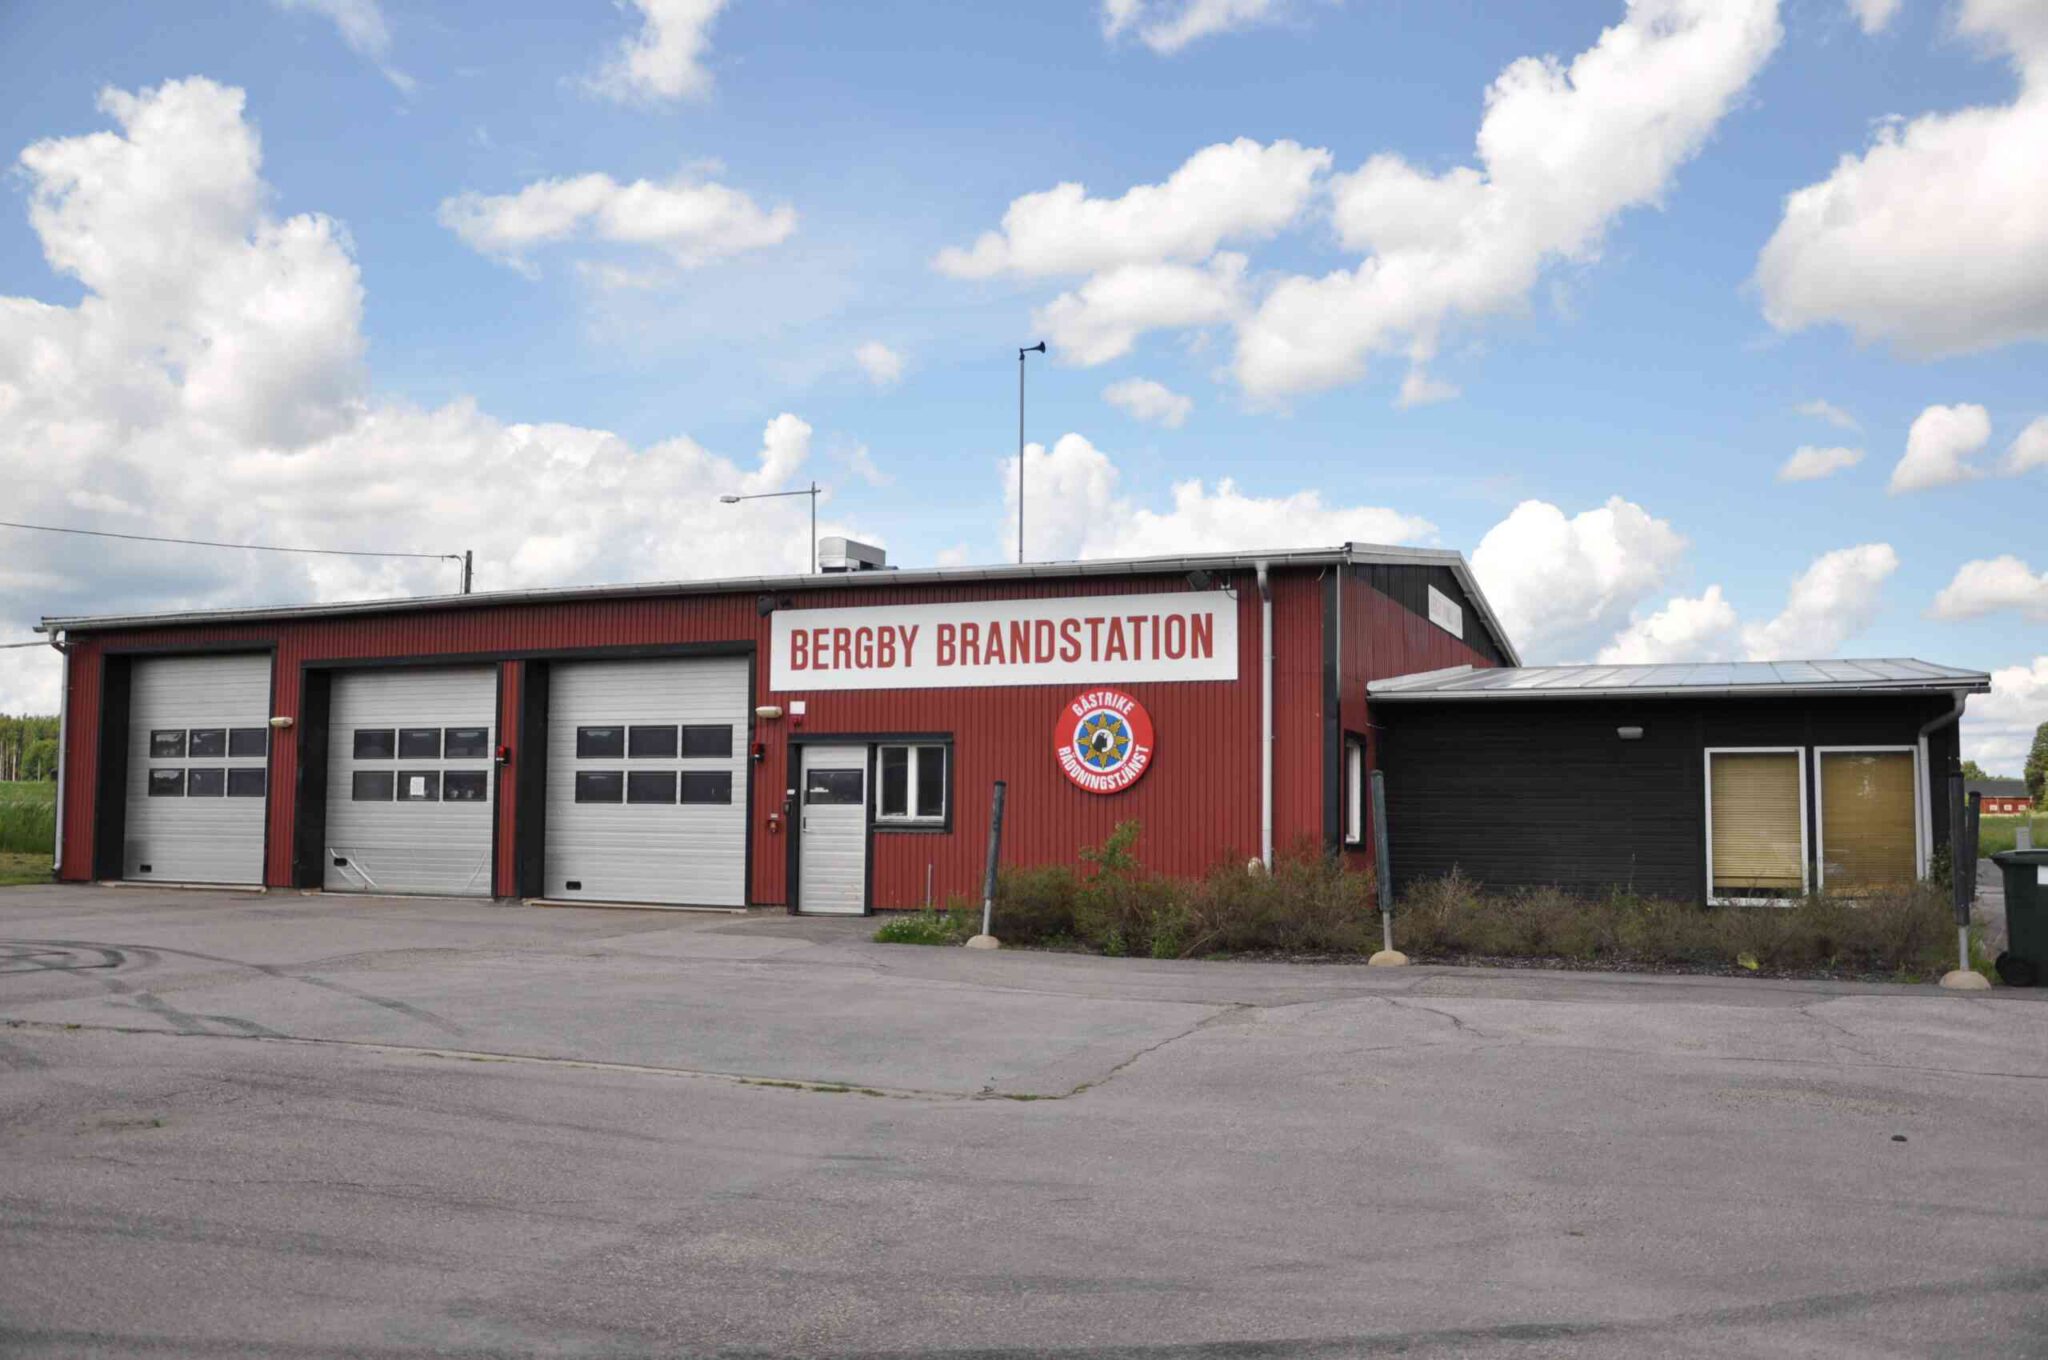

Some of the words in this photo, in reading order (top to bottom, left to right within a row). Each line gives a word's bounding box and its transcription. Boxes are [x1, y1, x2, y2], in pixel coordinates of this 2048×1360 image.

[790, 624, 919, 670] BERGBY
[936, 612, 1214, 667] BRANDSTATION
[1071, 691, 1135, 717] GÄSTRIKE
[1058, 744, 1149, 790] RÄDDNINGSTJÄNST
